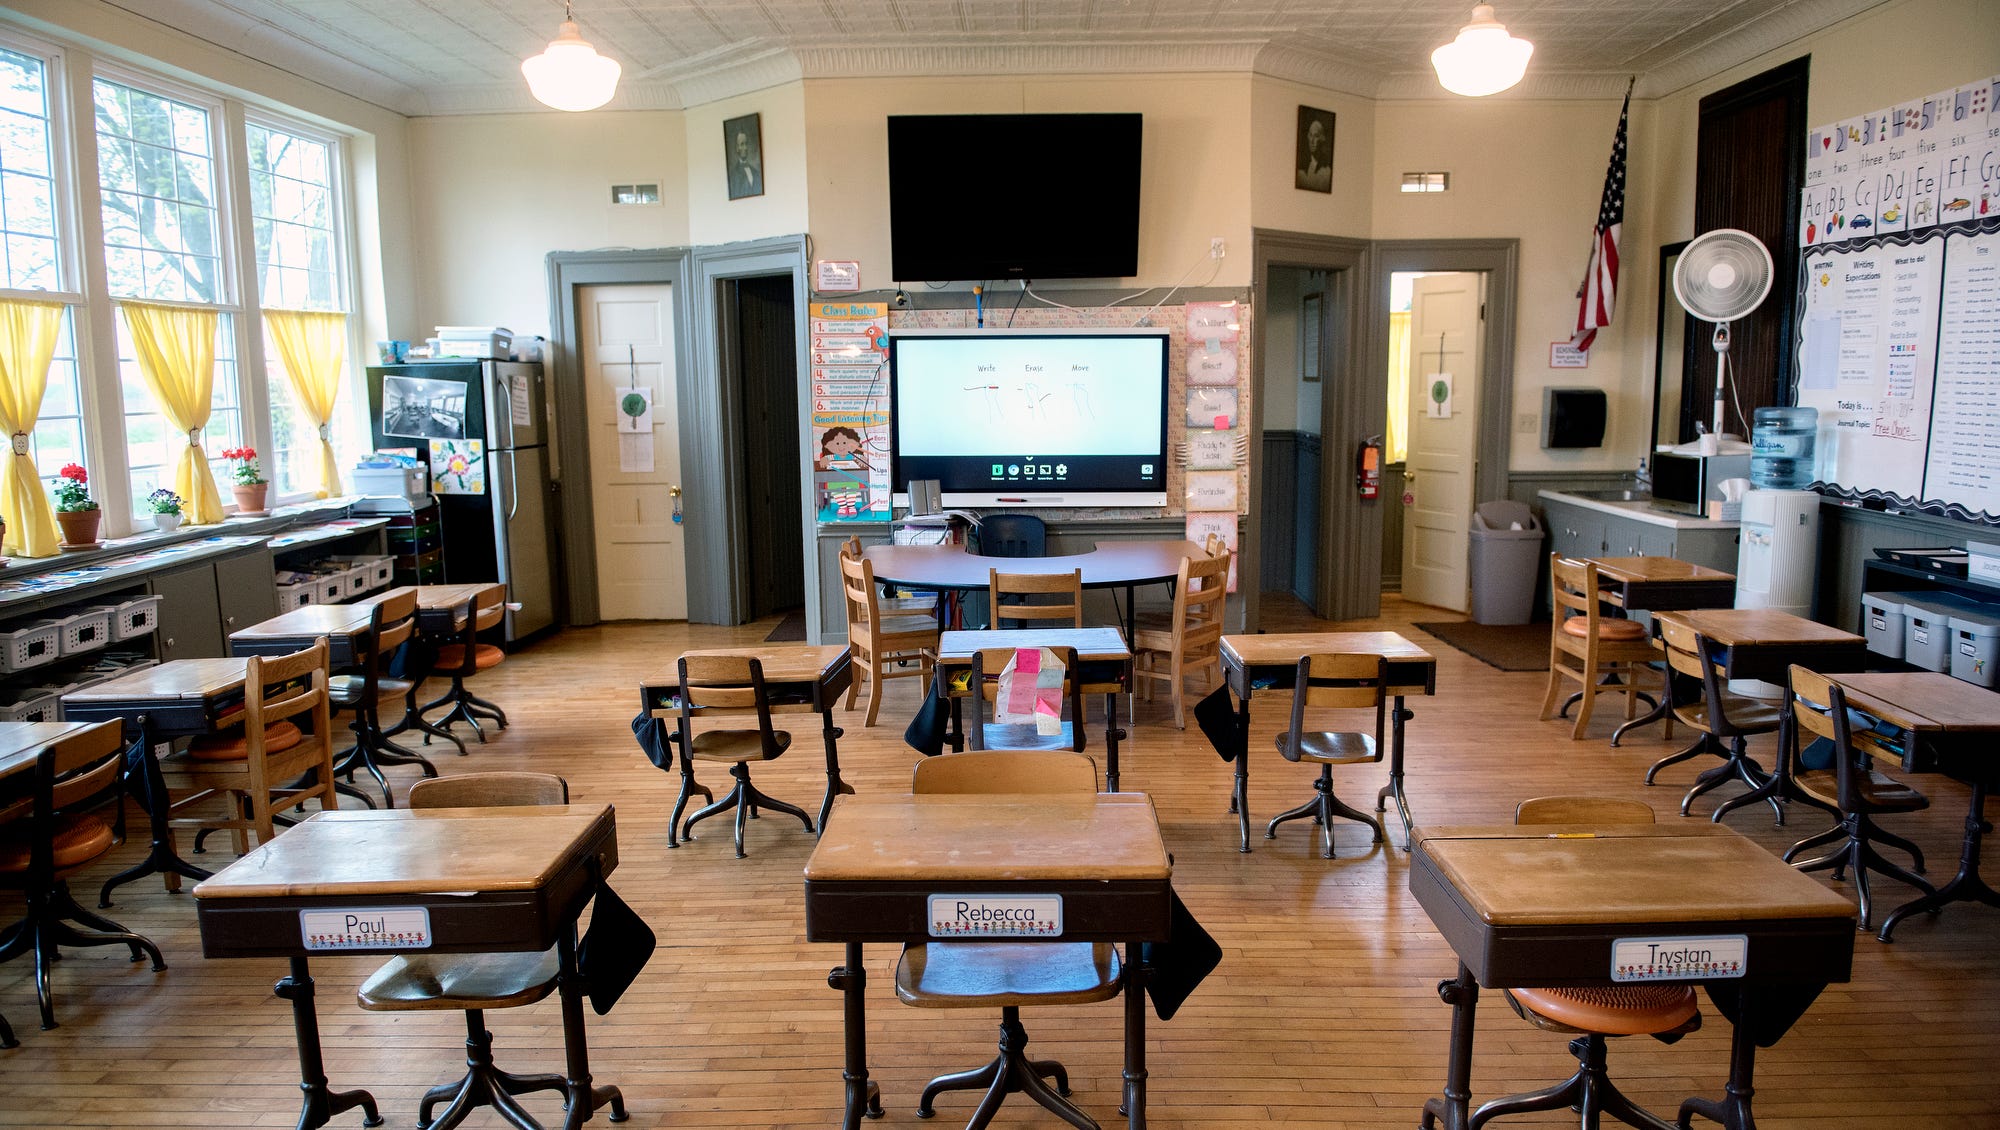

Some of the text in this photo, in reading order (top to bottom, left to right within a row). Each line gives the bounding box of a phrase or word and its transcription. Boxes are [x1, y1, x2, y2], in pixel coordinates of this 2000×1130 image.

[1836, 127, 1844, 153] 2
[1862, 119, 1871, 146] 3
[1892, 109, 1905, 137] 4
[1920, 101, 1932, 131] 5
[1954, 93, 1964, 121] 6
[1808, 170, 1822, 180] one
[1834, 160, 1848, 174] two
[1861, 153, 1883, 168] three
[1889, 146, 1906, 162] four
[1920, 139, 1936, 153] five
[1952, 135, 1967, 147] six
[1804, 193, 1821, 219] Aa
[1829, 186, 1846, 213] Bb
[1855, 179, 1870, 206] Cc
[1883, 170, 1905, 202] Dd
[1916, 166, 1934, 196] Ee
[1948, 155, 1970, 189] Ff
[1853, 260, 1875, 269] Writing
[1845, 272, 1881, 282] Expectations
[822, 304, 877, 317] Class Rules
[815, 353, 826, 364] 3.
[816, 369, 826, 379] 4.
[977, 364, 1090, 373] Write Erase Move
[816, 385, 826, 395] 5.
[816, 400, 826, 411] 6.
[1837, 400, 1856, 411] Today
[1856, 401, 1862, 410] is
[813, 413, 888, 425] Good Listening Tips
[1873, 417, 1890, 434] Free
[876, 466, 888, 474] Lips
[956, 901, 1035, 921] Rebecca
[345, 914, 386, 934] Paul
[1647, 943, 1712, 968] Trystan
